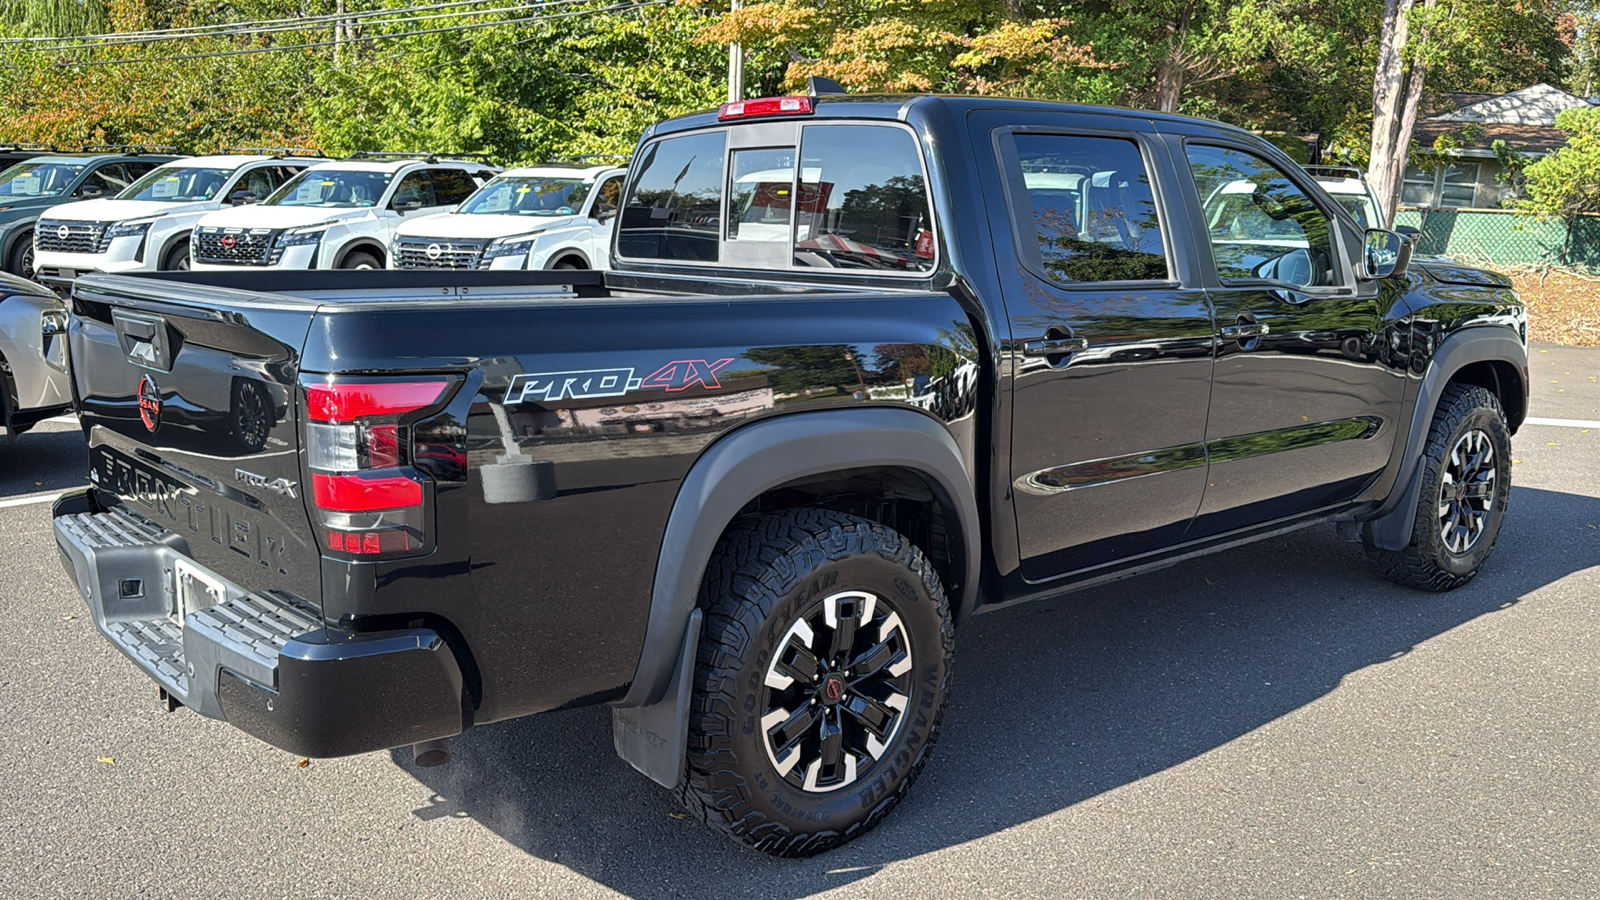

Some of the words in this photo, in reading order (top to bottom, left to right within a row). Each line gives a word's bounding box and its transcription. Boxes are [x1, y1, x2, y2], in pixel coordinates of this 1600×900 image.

[503, 358, 735, 405] PRO-4X
[100, 451, 287, 575] FRONTIER
[235, 468, 298, 499] PRO-4X
[741, 569, 840, 735] GOODYEAR
[859, 663, 938, 809] WRANGLER
